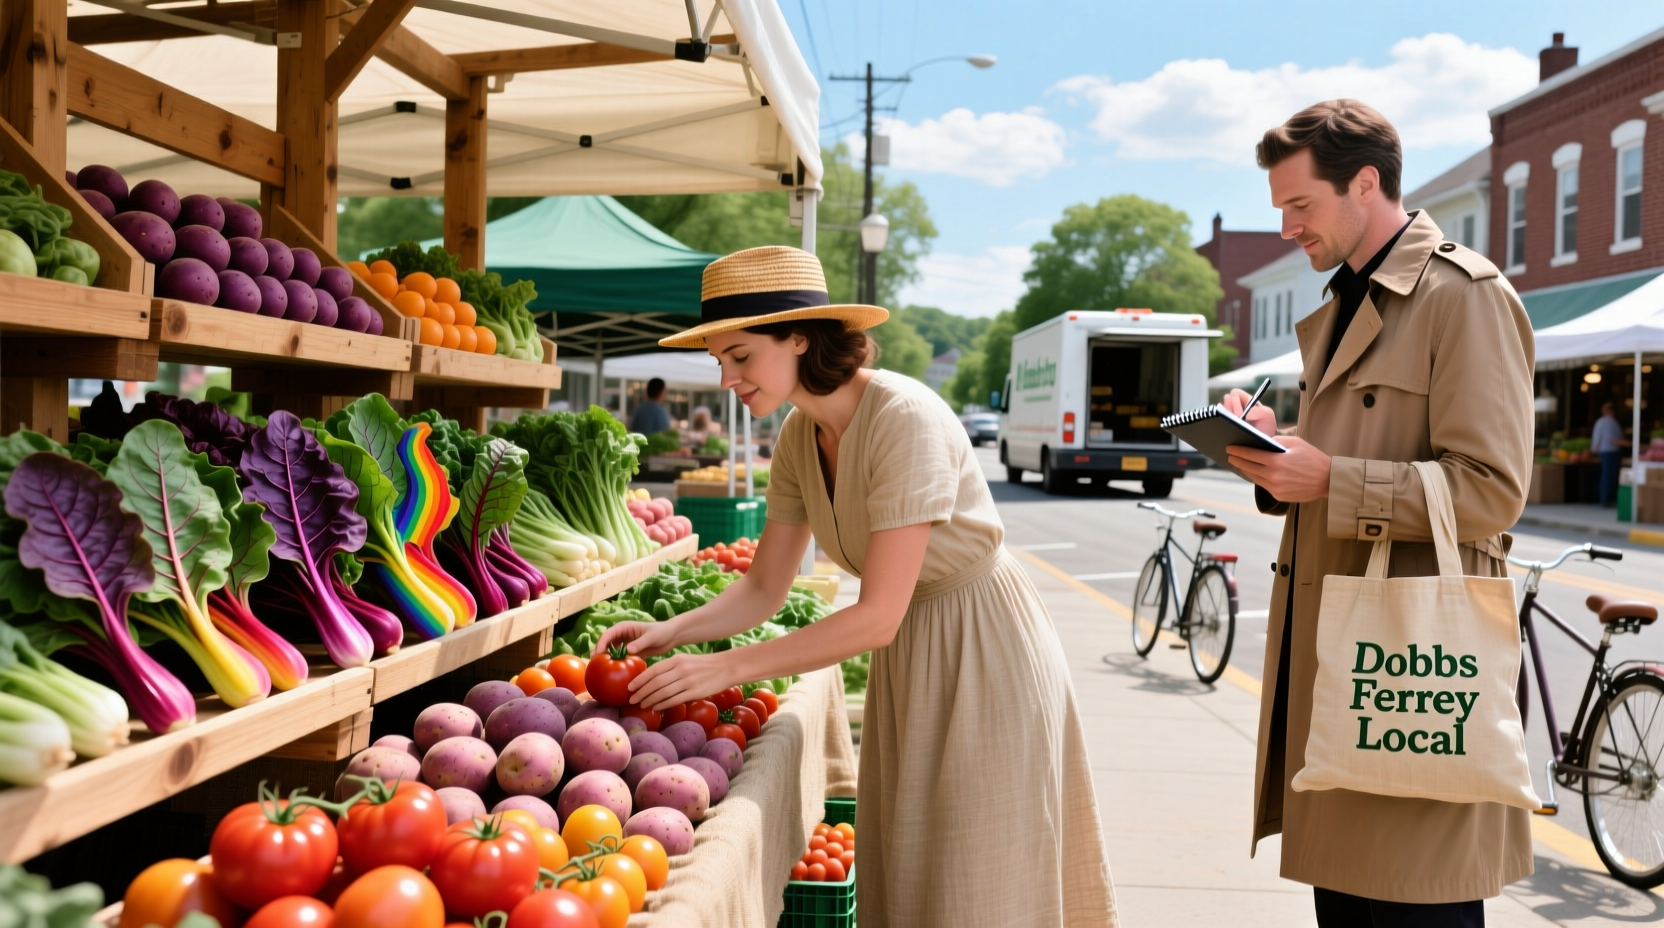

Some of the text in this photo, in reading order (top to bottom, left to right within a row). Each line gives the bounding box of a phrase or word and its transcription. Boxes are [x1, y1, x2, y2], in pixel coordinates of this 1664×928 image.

[1351, 641, 1478, 678] Dobbs
[1349, 678, 1480, 723] Ferrey
[1356, 716, 1466, 755] Local
